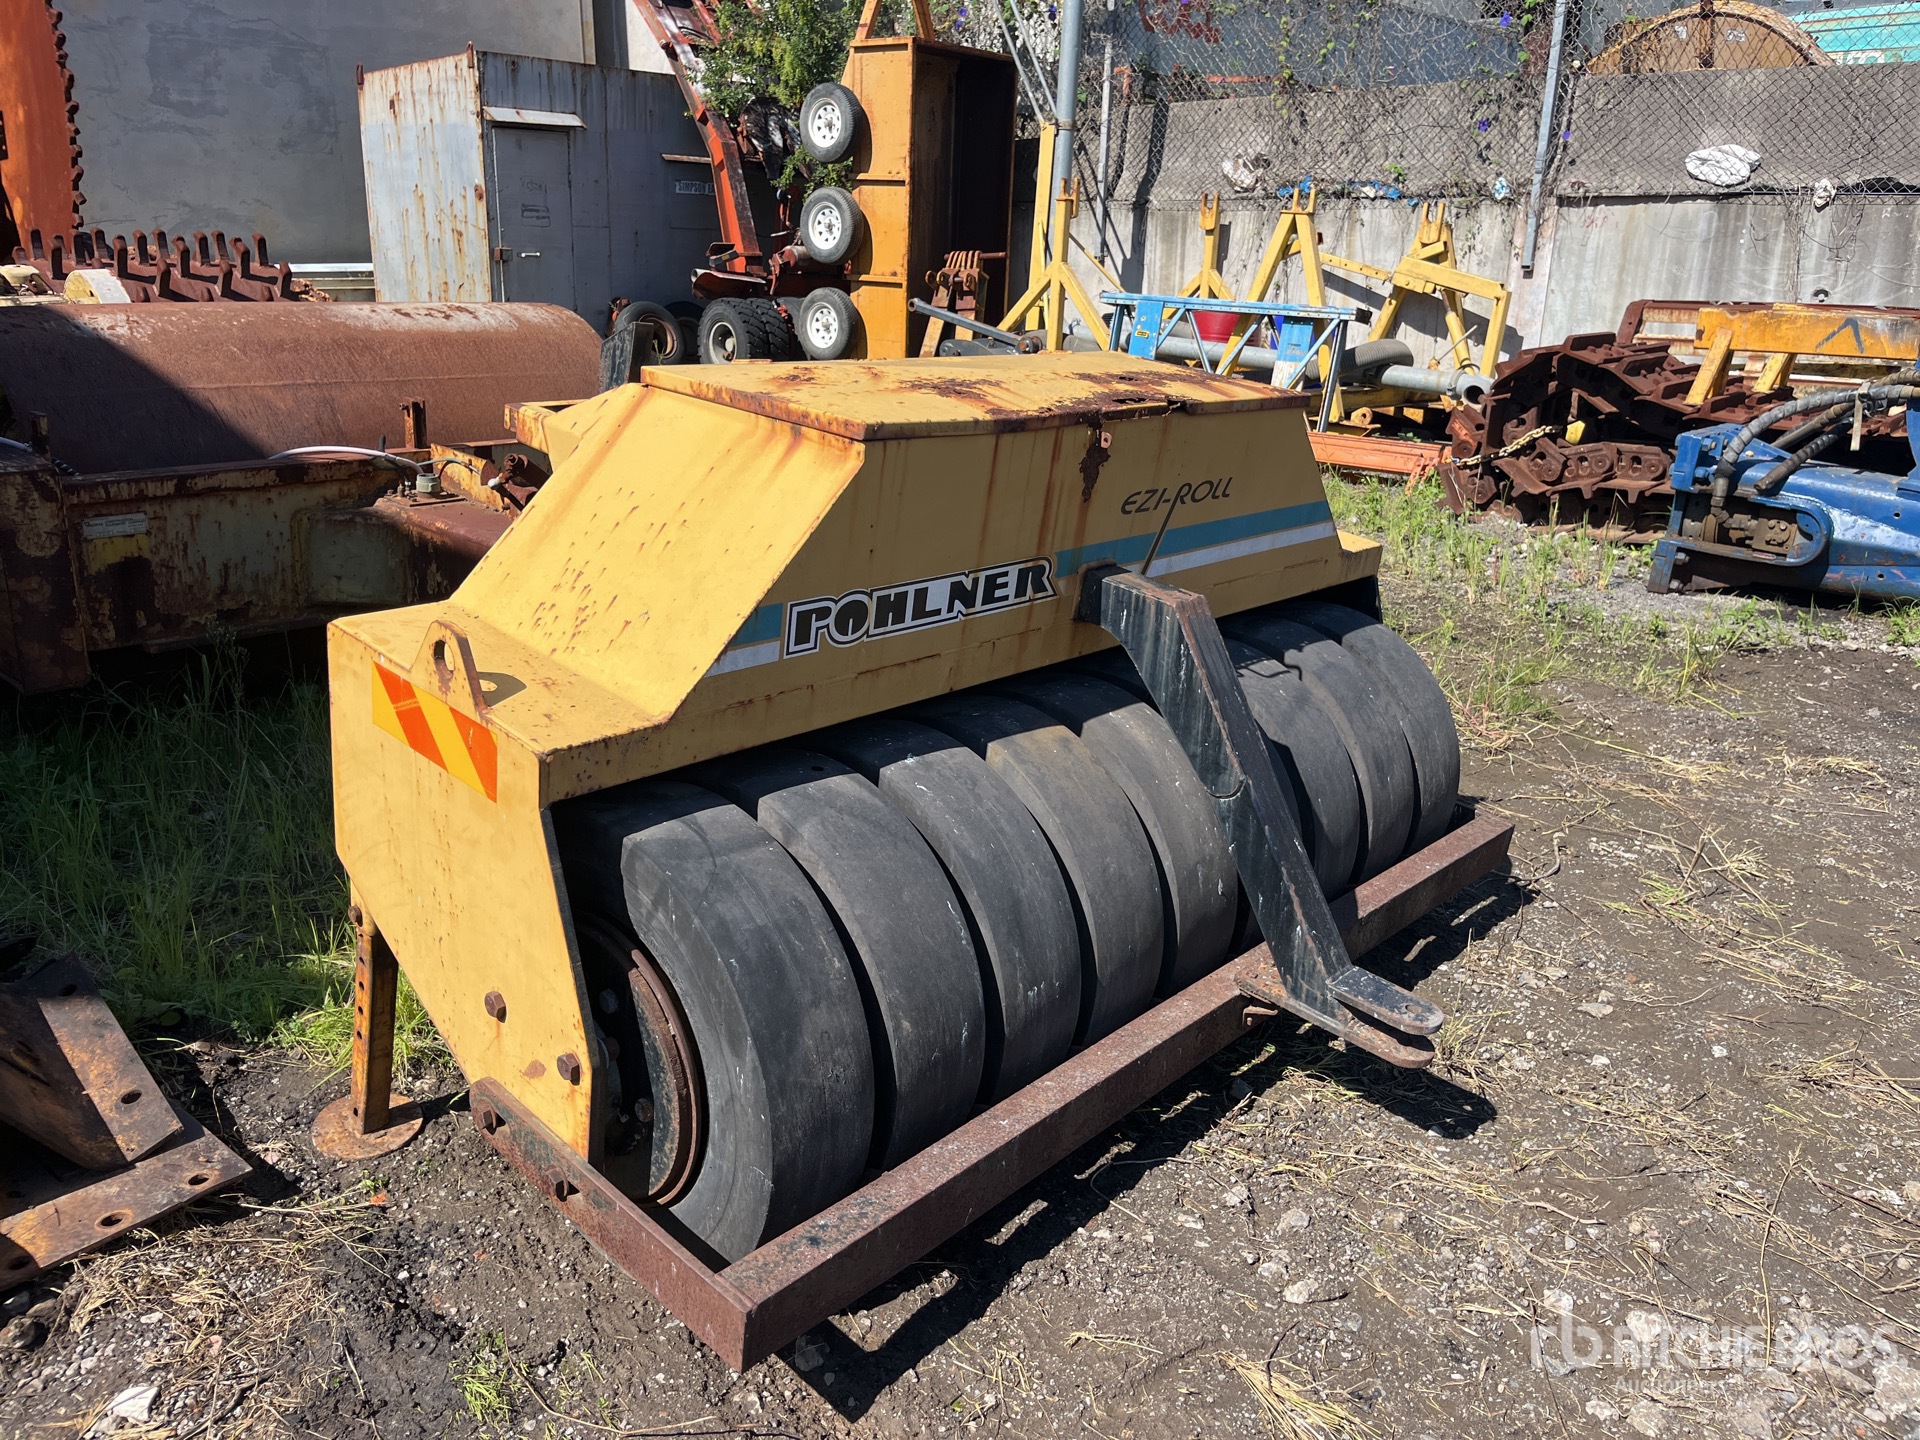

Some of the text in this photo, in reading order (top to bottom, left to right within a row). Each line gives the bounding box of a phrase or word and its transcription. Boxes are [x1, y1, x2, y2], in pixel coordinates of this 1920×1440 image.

[678, 181, 706, 194] SIMPSON
[1120, 476, 1234, 516] EZI-ROLL
[792, 562, 1050, 648] POHLNER
